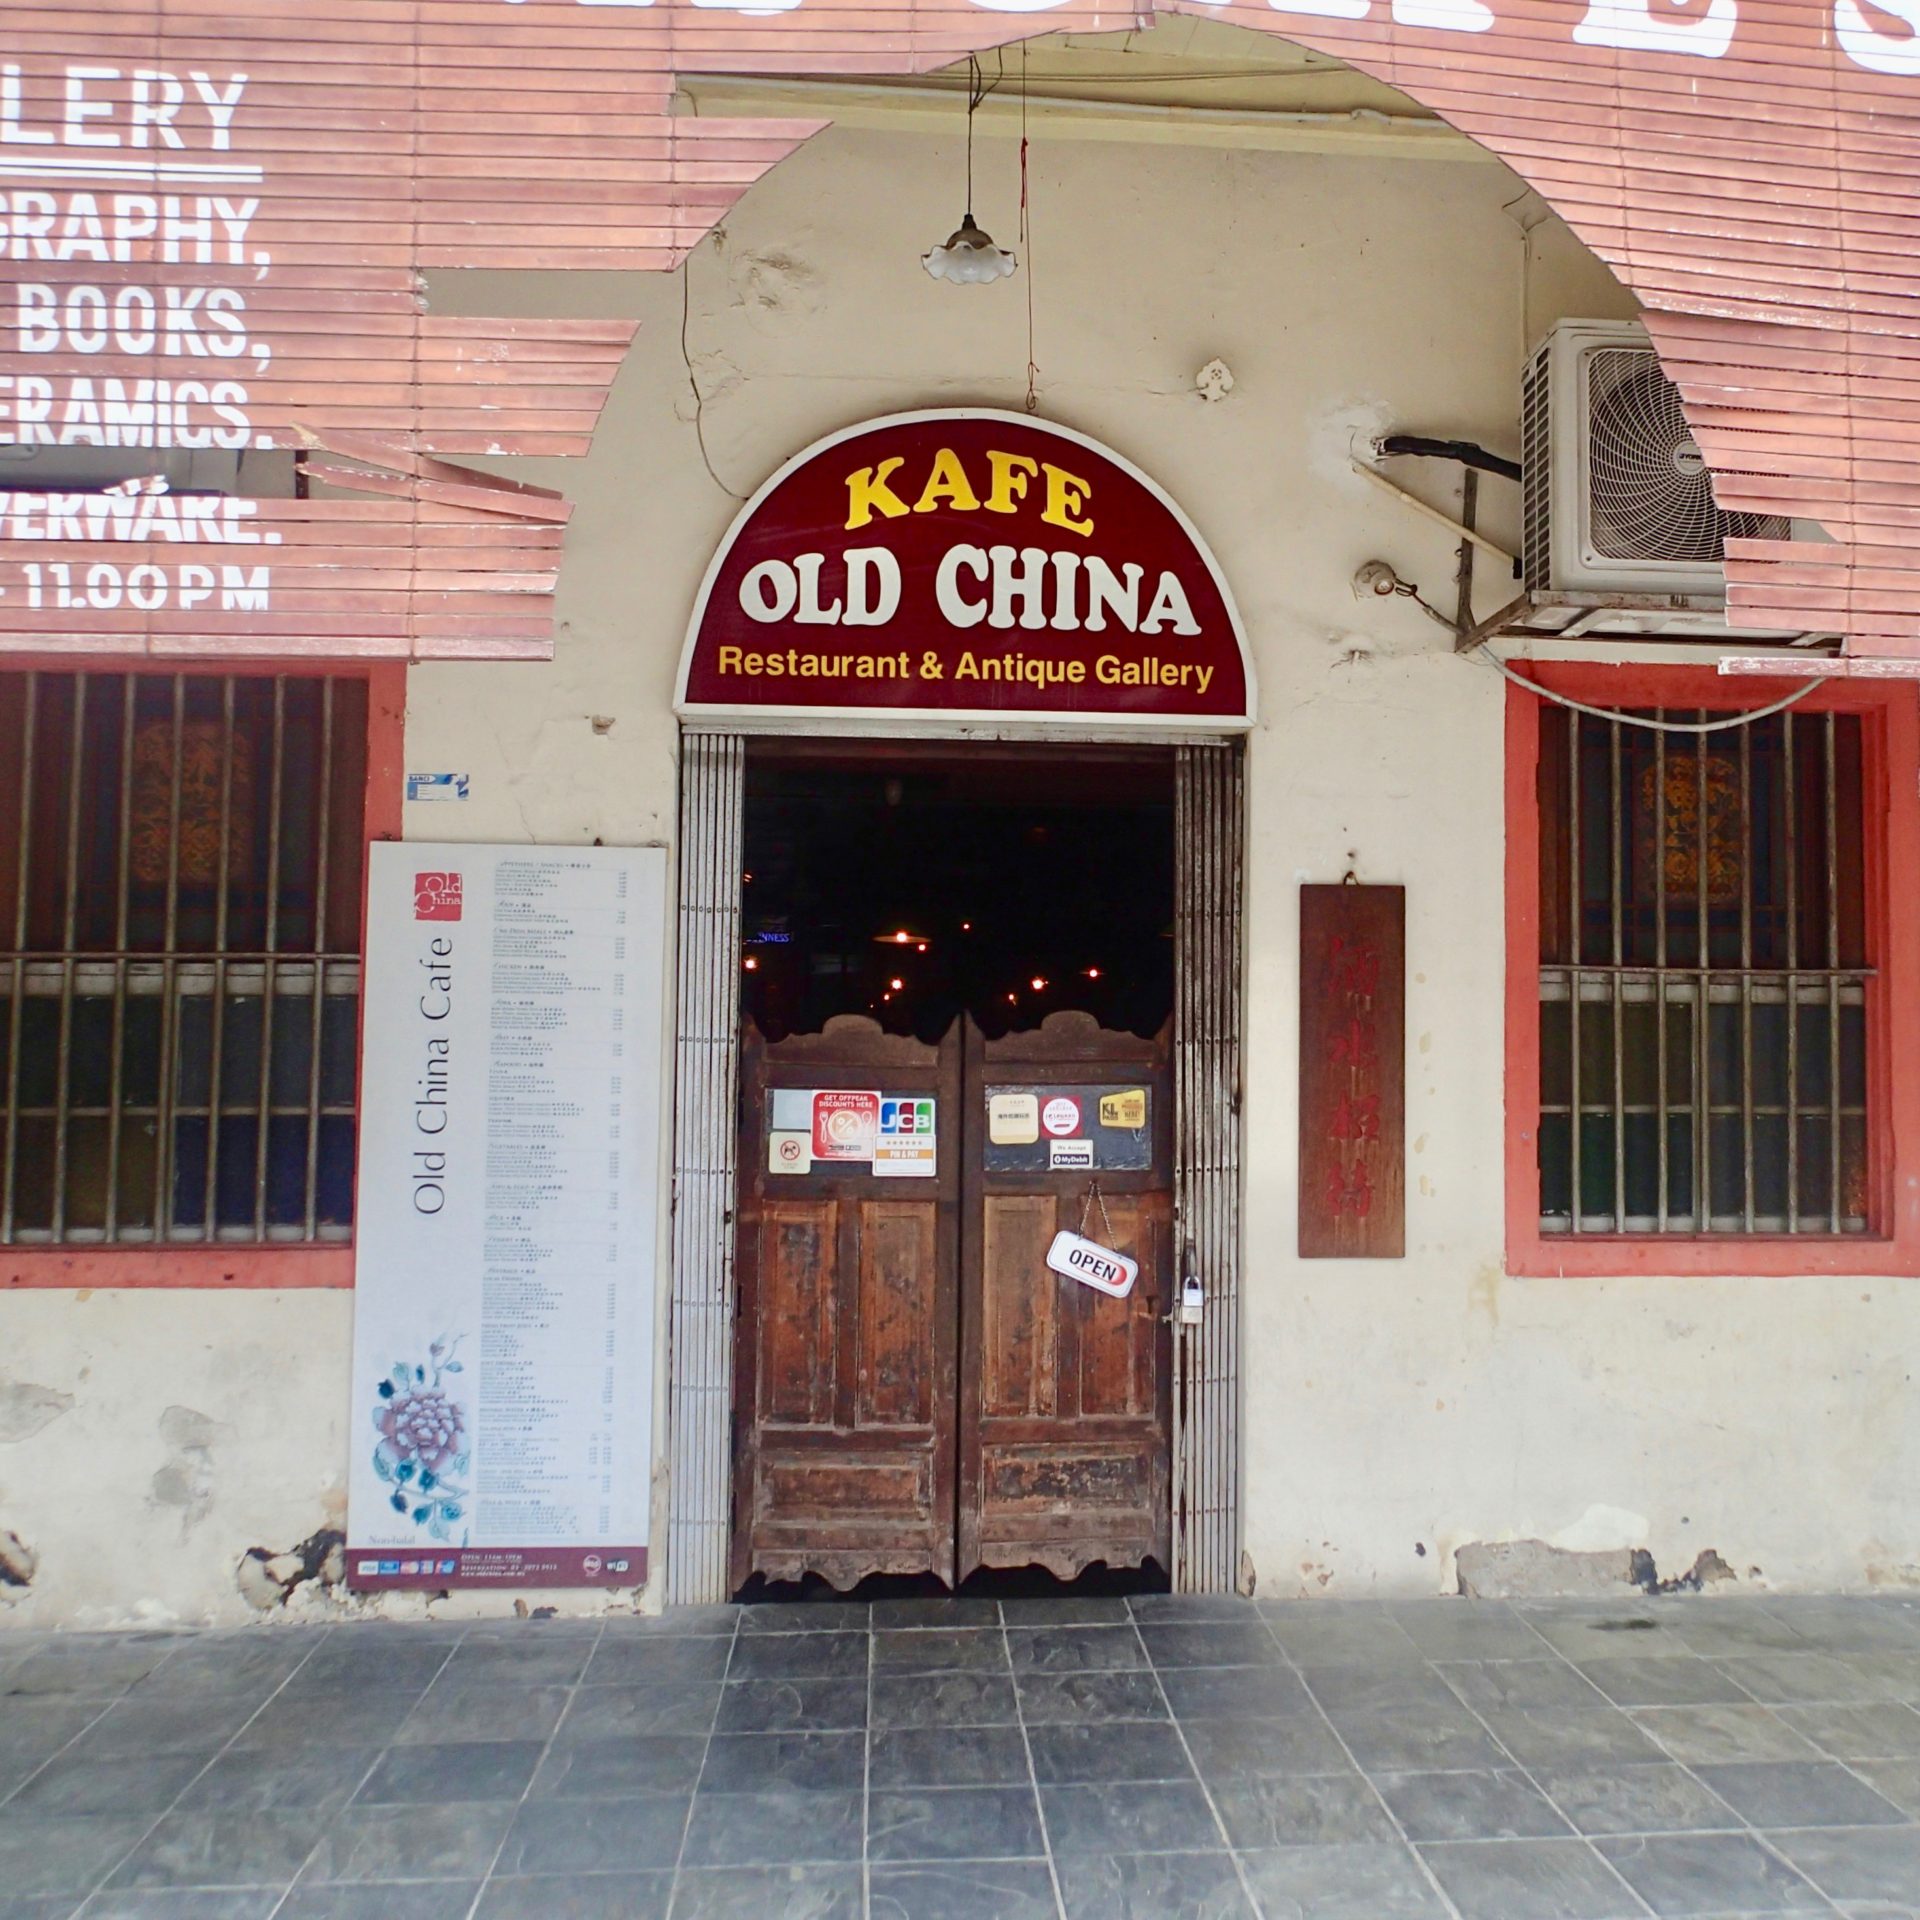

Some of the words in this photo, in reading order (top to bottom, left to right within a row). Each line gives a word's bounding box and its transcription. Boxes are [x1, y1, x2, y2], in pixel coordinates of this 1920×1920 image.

[0, 191, 271, 281] RAPHY,
[18, 283, 271, 373] BOOKS,
[844, 447, 1094, 537] KAFE
[738, 546, 902, 625] OLD
[935, 543, 1202, 635] CHINA
[718, 646, 909, 680] Restaurant
[919, 652, 944, 680] &
[955, 651, 1086, 689] Antique
[1096, 654, 1214, 693] Gallery
[425, 875, 462, 895] Old
[419, 937, 453, 1021] Cafe
[415, 1038, 448, 1134] China
[881, 1112, 931, 1130] JCB
[412, 1151, 446, 1215] Old
[1062, 1156, 1088, 1164] MyDebit
[1069, 1249, 1117, 1281] OPEN
